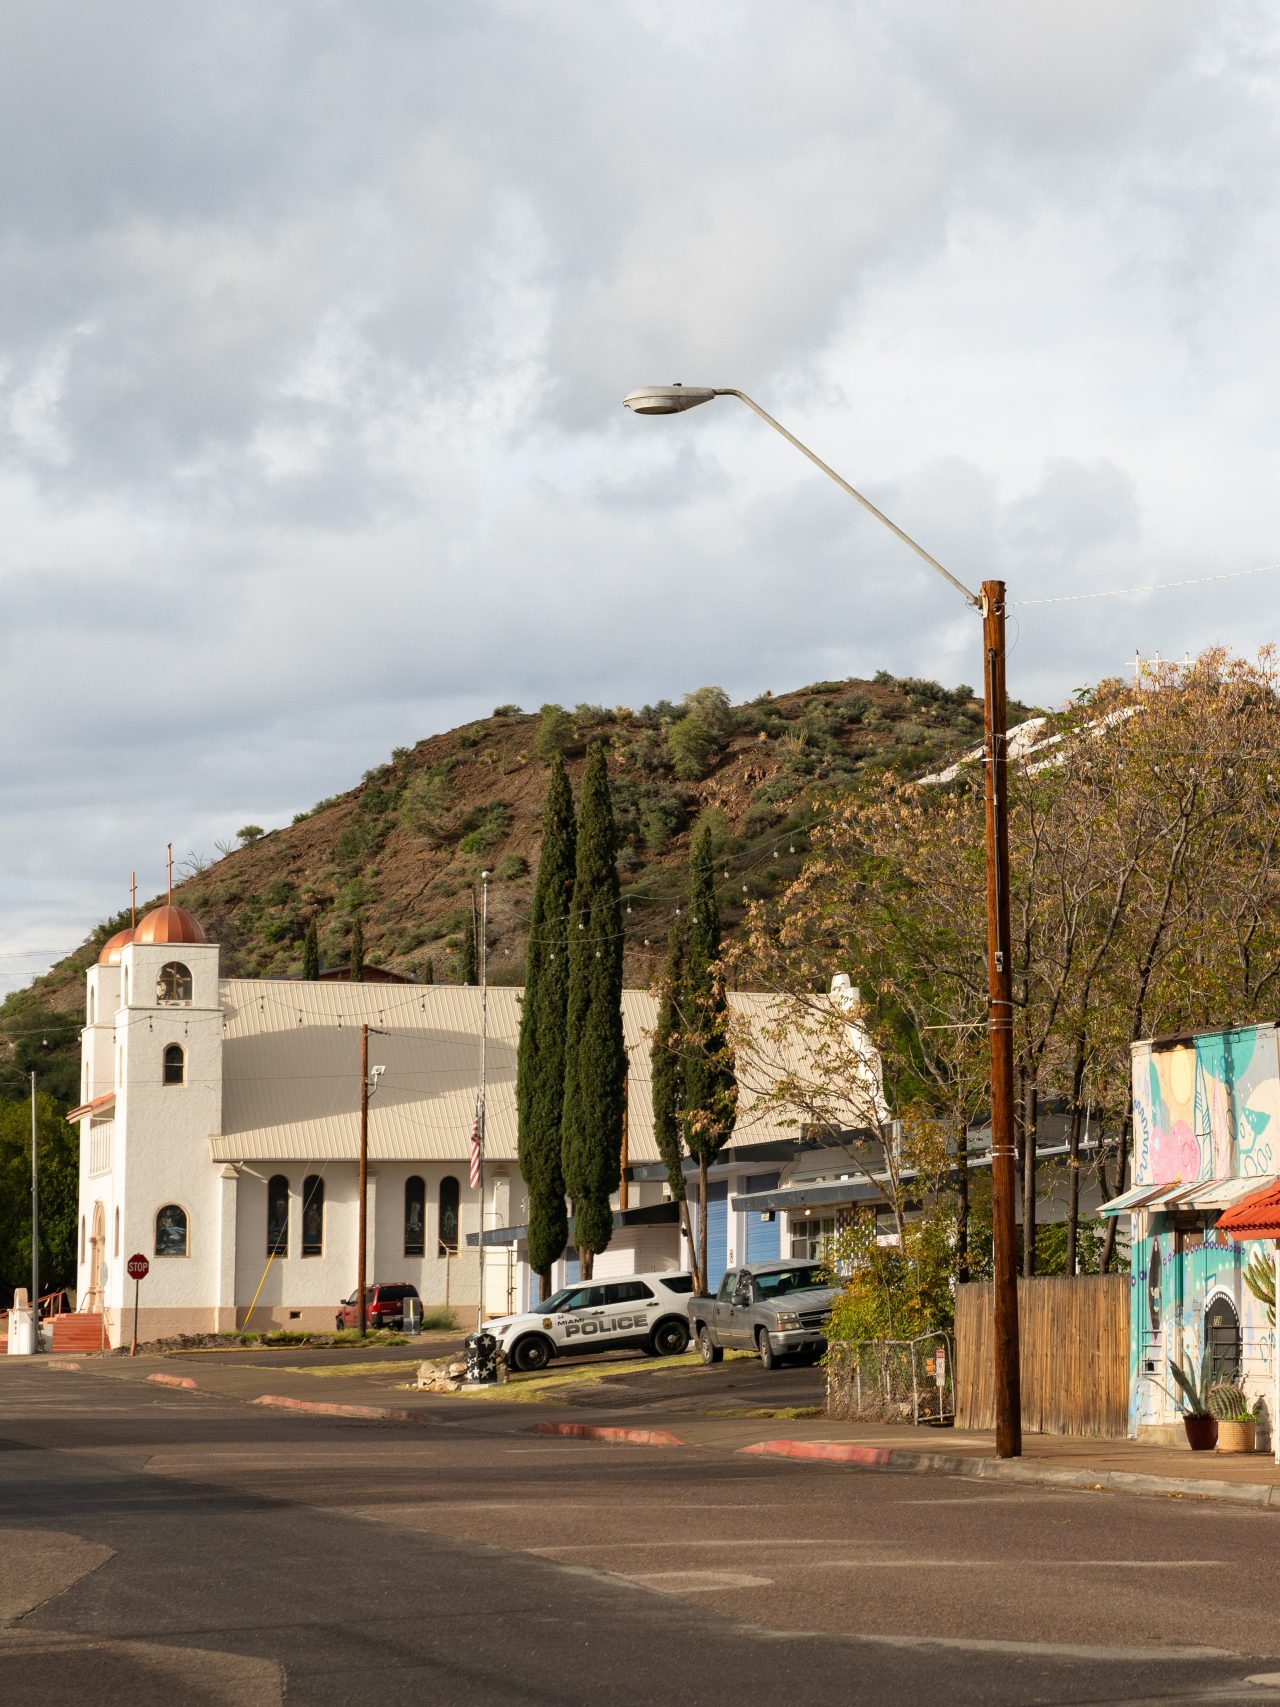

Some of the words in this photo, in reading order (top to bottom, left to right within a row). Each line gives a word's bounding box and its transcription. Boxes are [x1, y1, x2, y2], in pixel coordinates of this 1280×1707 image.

[128, 1262, 148, 1272] STOP
[557, 1317, 584, 1326] MIAMI
[565, 1314, 648, 1338] POLICE
